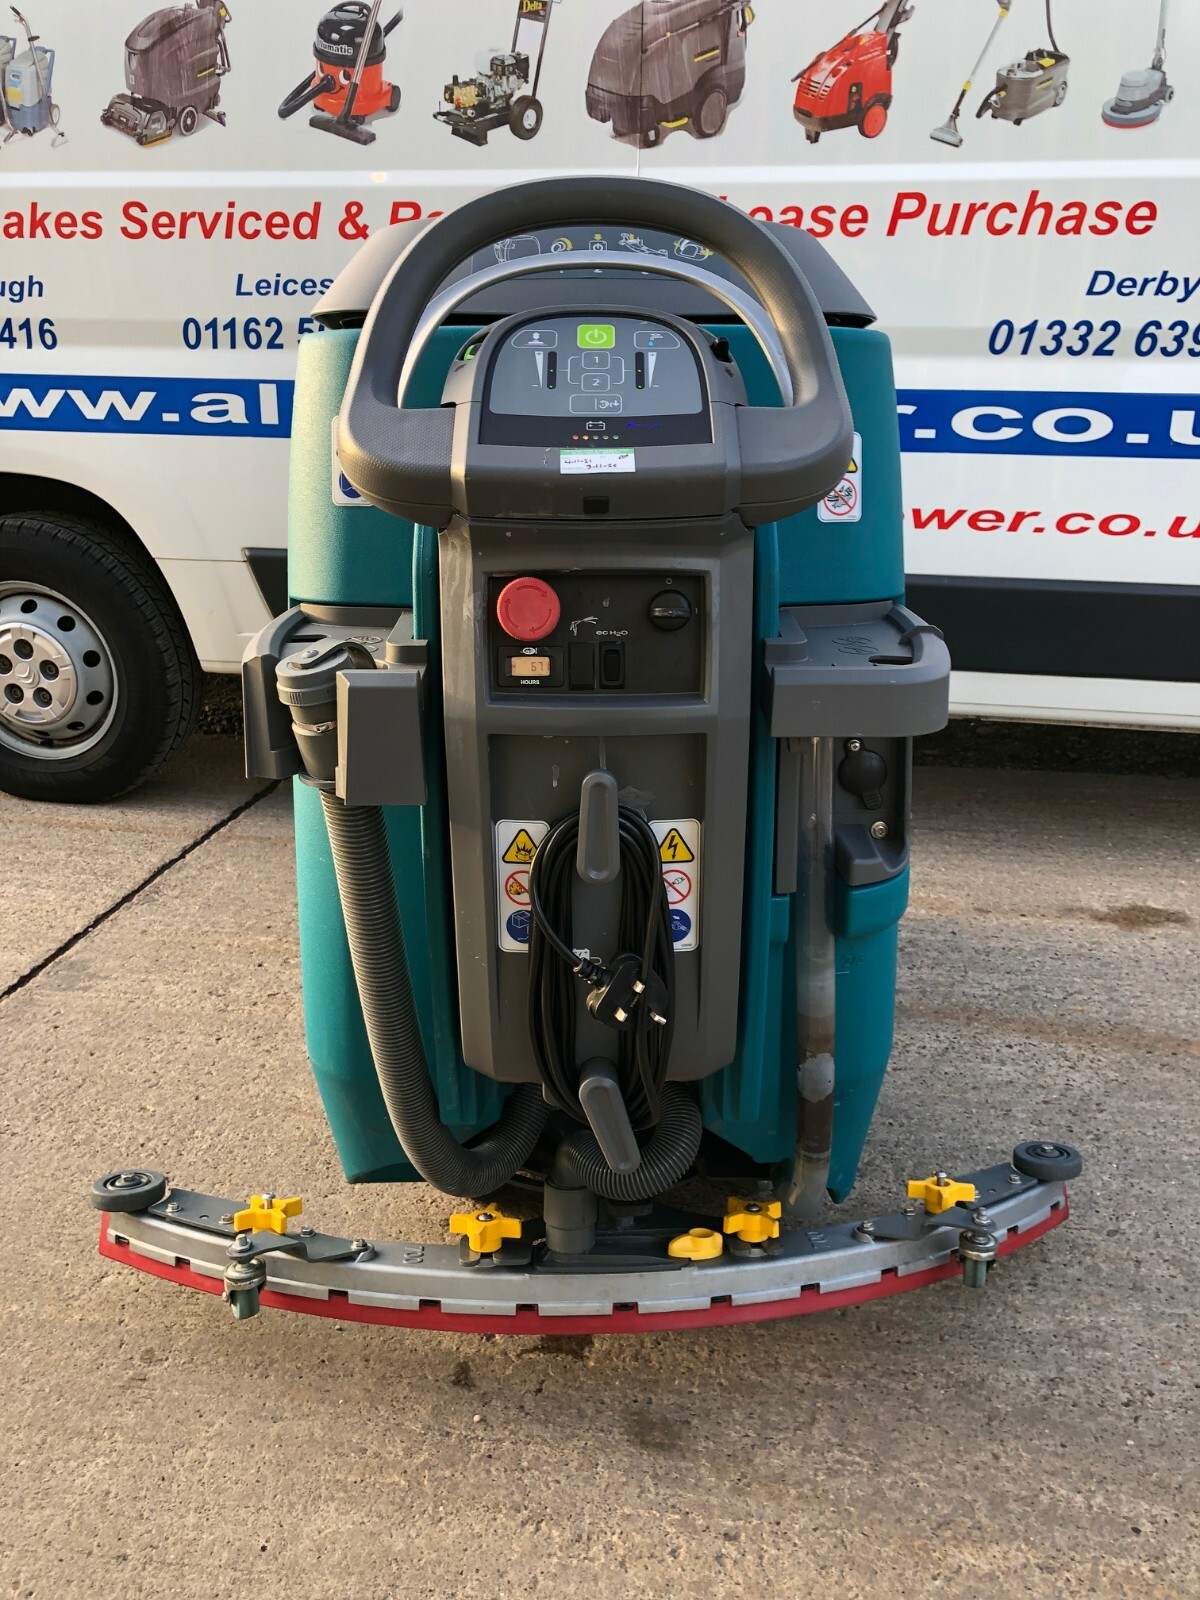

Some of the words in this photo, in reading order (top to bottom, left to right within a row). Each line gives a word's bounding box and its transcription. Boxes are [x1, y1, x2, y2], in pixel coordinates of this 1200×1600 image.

[2, 202, 103, 240] akes
[120, 201, 322, 240] Serviced
[338, 201, 369, 240] &
[886, 190, 1158, 236] Purchase
[1086, 270, 1200, 303] Derby
[0, 317, 58, 350] 416
[183, 317, 284, 350] 01162
[988, 319, 1121, 356] 01332
[592, 378, 600, 387] 2
[902, 507, 1200, 539] wer.co.u
